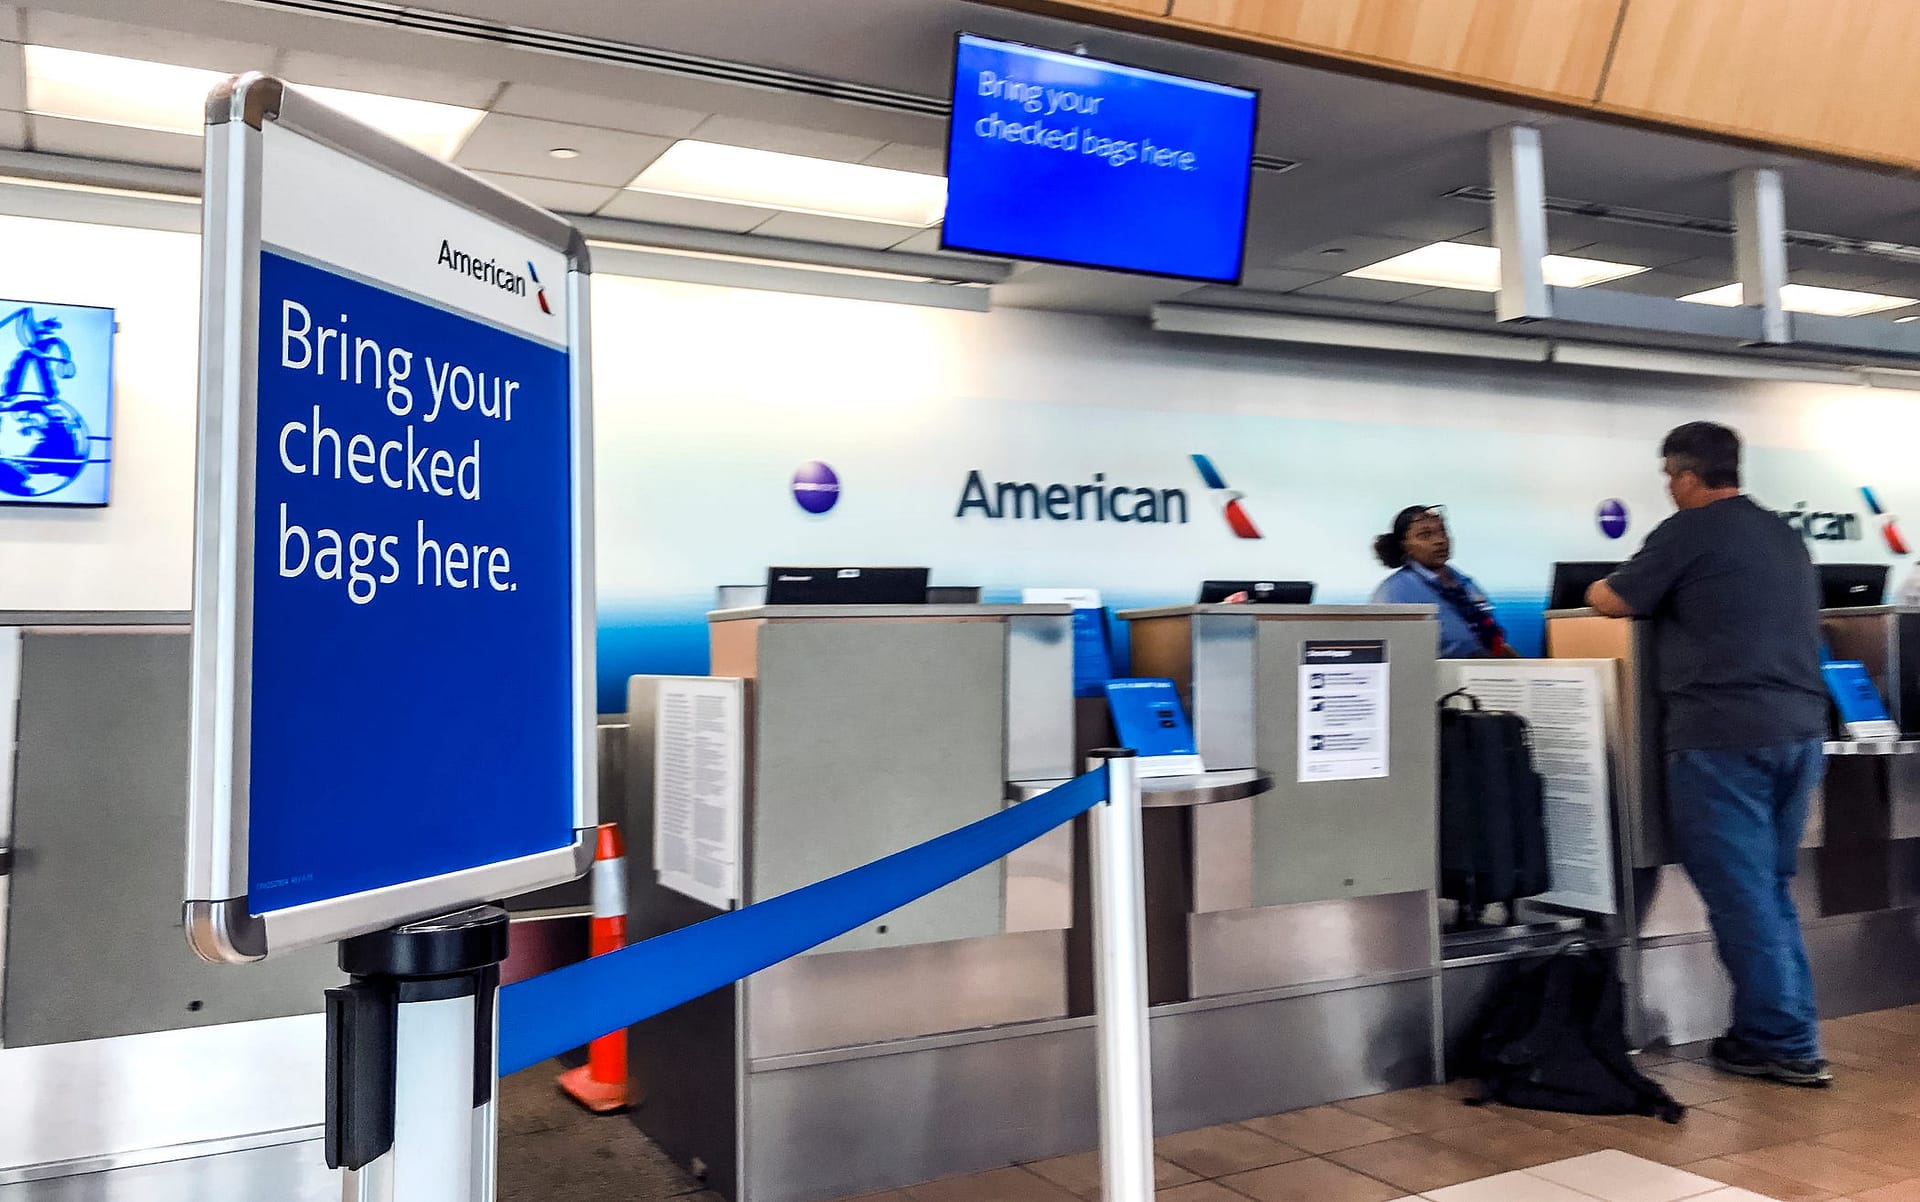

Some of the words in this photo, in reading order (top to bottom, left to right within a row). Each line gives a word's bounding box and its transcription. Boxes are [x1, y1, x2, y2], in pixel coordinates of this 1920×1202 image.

[978, 71, 1043, 113] Bring
[1046, 89, 1104, 116] your
[976, 113, 1077, 151] checked
[1082, 130, 1139, 167] bags
[437, 240, 527, 297] American
[282, 300, 413, 416] Bring
[424, 357, 520, 422] your
[279, 405, 481, 501] checked
[956, 470, 1188, 523] American
[279, 503, 400, 605] bags
[417, 519, 517, 592] here.
